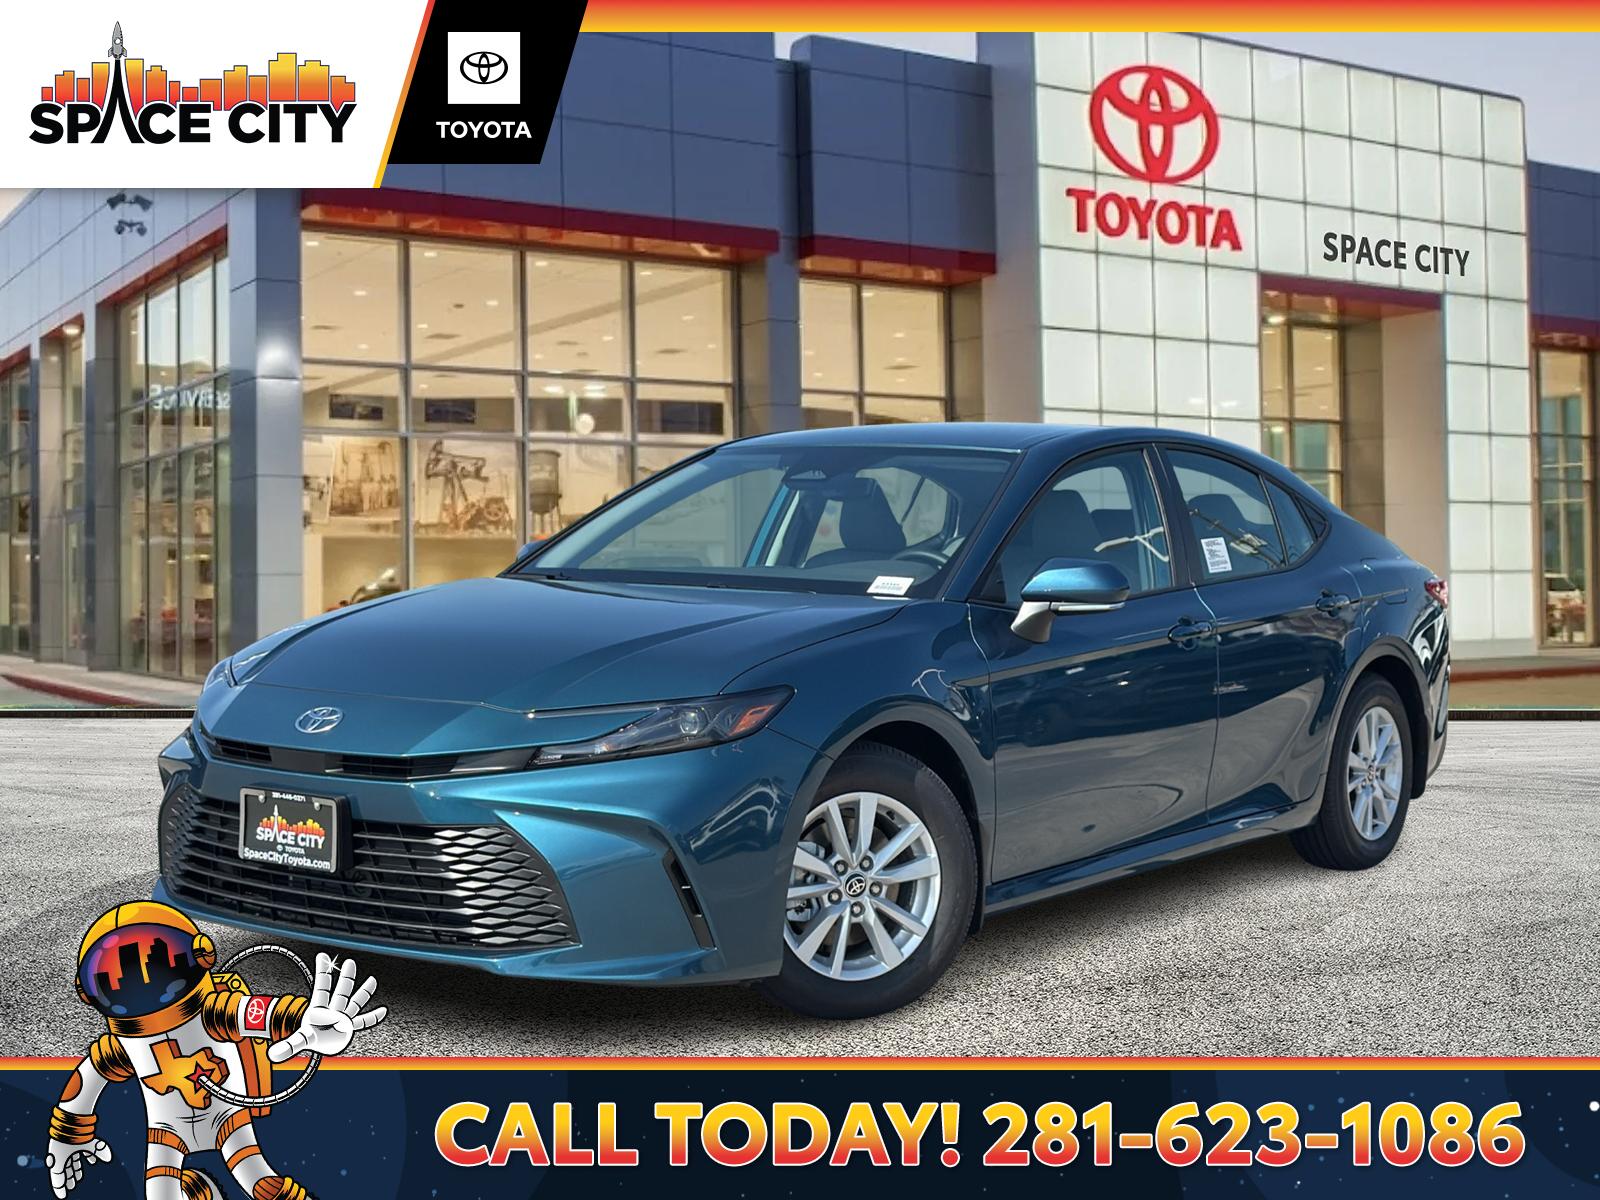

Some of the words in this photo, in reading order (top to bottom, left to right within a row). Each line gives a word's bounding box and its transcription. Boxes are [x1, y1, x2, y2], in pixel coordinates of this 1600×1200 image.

[1066, 188, 1243, 251] TOYOTA
[1323, 232, 1407, 270] SPACE
[1414, 245, 1470, 277] CITY
[256, 817, 296, 844] SPACE
[297, 833, 325, 849] CITY
[244, 847, 330, 869] SpaceCityToyota.com
[285, 846, 305, 854] TOYOTA
